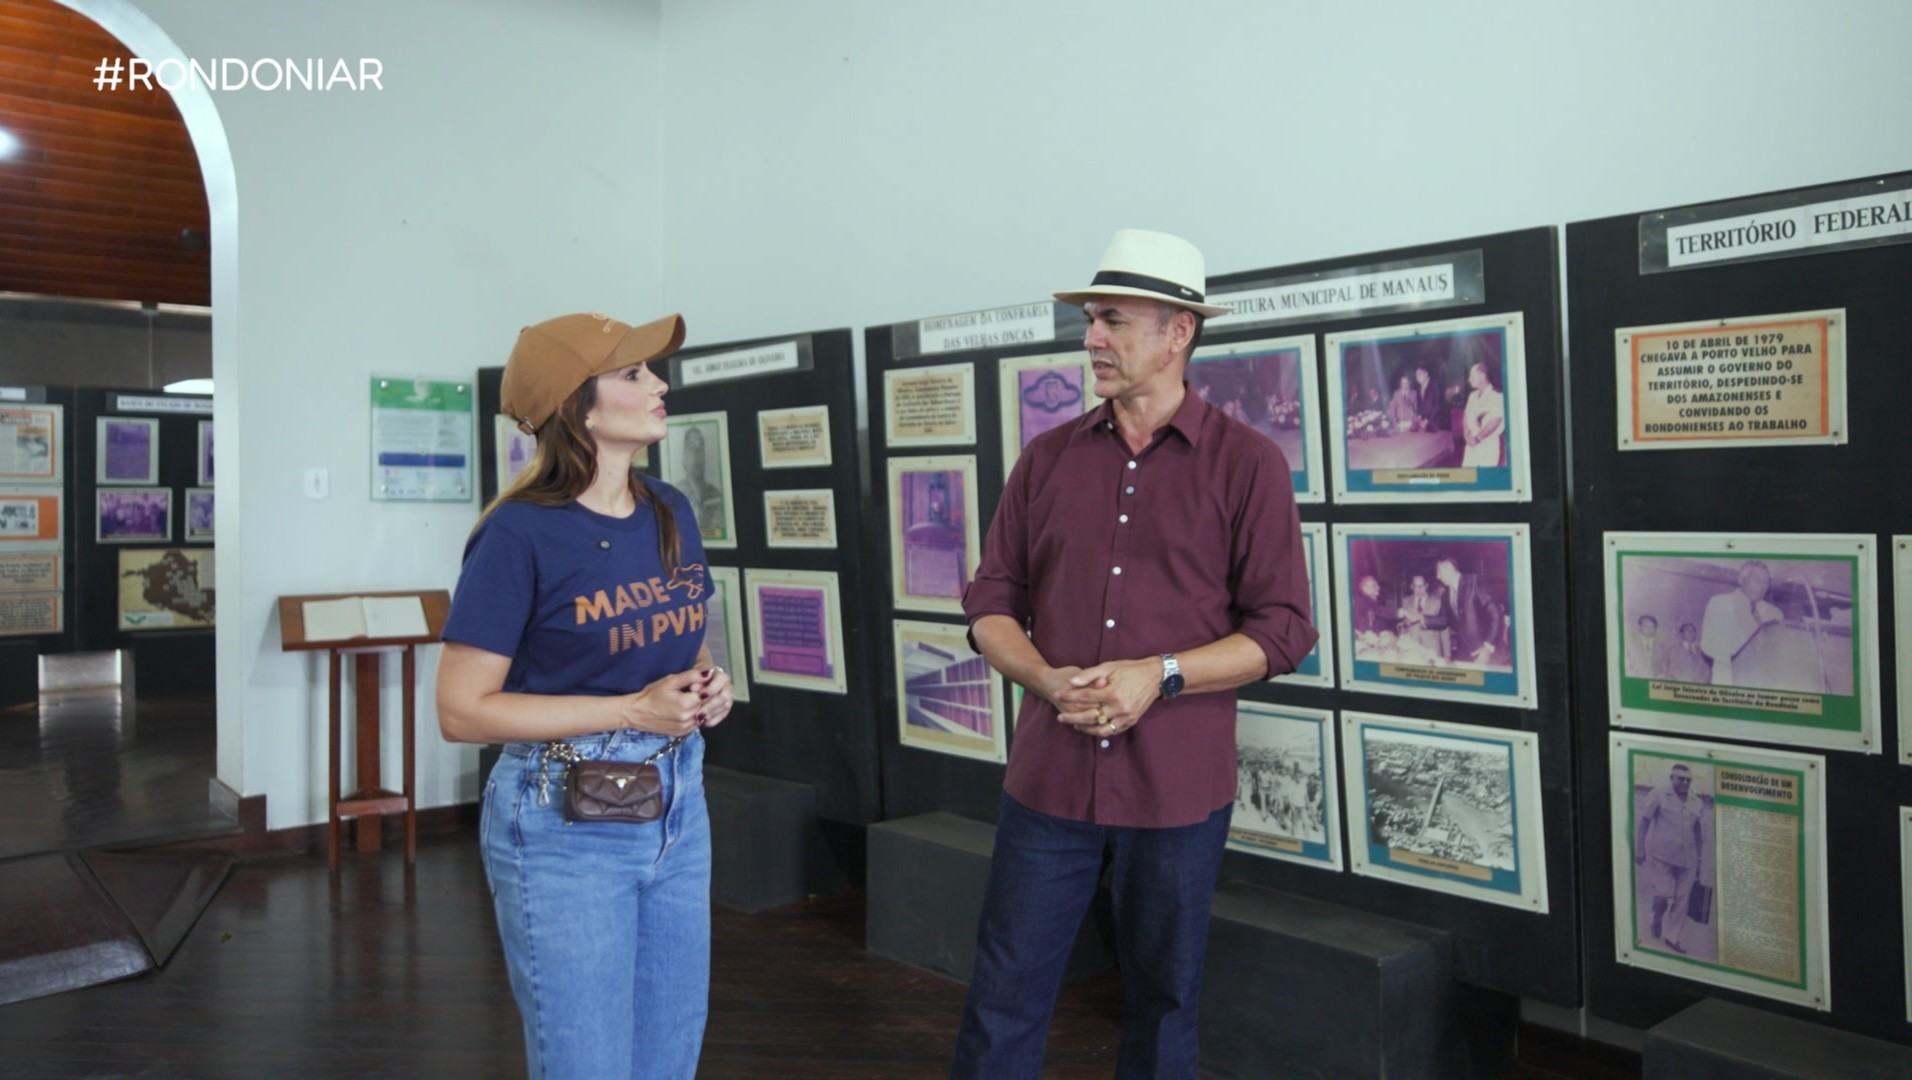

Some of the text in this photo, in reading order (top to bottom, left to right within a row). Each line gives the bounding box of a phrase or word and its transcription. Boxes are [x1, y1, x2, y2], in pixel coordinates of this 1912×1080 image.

[1675, 201, 1912, 255] TERRITÓRIO FEDERAL
[1280, 286, 1356, 309] MUNICIPAL
[1360, 281, 1378, 299] DE
[1382, 273, 1448, 297] MANAUS
[923, 304, 1049, 332] HOMENAGEM DA CONFRARIA
[943, 336, 961, 349] DAS
[963, 332, 999, 347] VELHAS
[1666, 333, 1784, 350] 10 DE ABRIL DE 1979
[1640, 343, 1812, 363] CHEGAVA A PORTO VELHO PARA
[1657, 360, 1792, 377] ASSUMIR O GOVERNO DO
[1648, 374, 1803, 392] TERRITÓRIO, DESPEDINDO-SE
[1667, 390, 1782, 404] DOS AMAZONENSES E
[1679, 405, 1769, 418] CONVIDANDO OS
[1645, 419, 1807, 433] RONDONIENSES AO TRABALHO
[574, 576, 671, 625] MADE
[609, 602, 704, 655] IN PVH
[1721, 771, 1793, 789] CONSOLIDAÇÃO DE UM
[1721, 781, 1793, 799] DESENVOLVIMENTO
